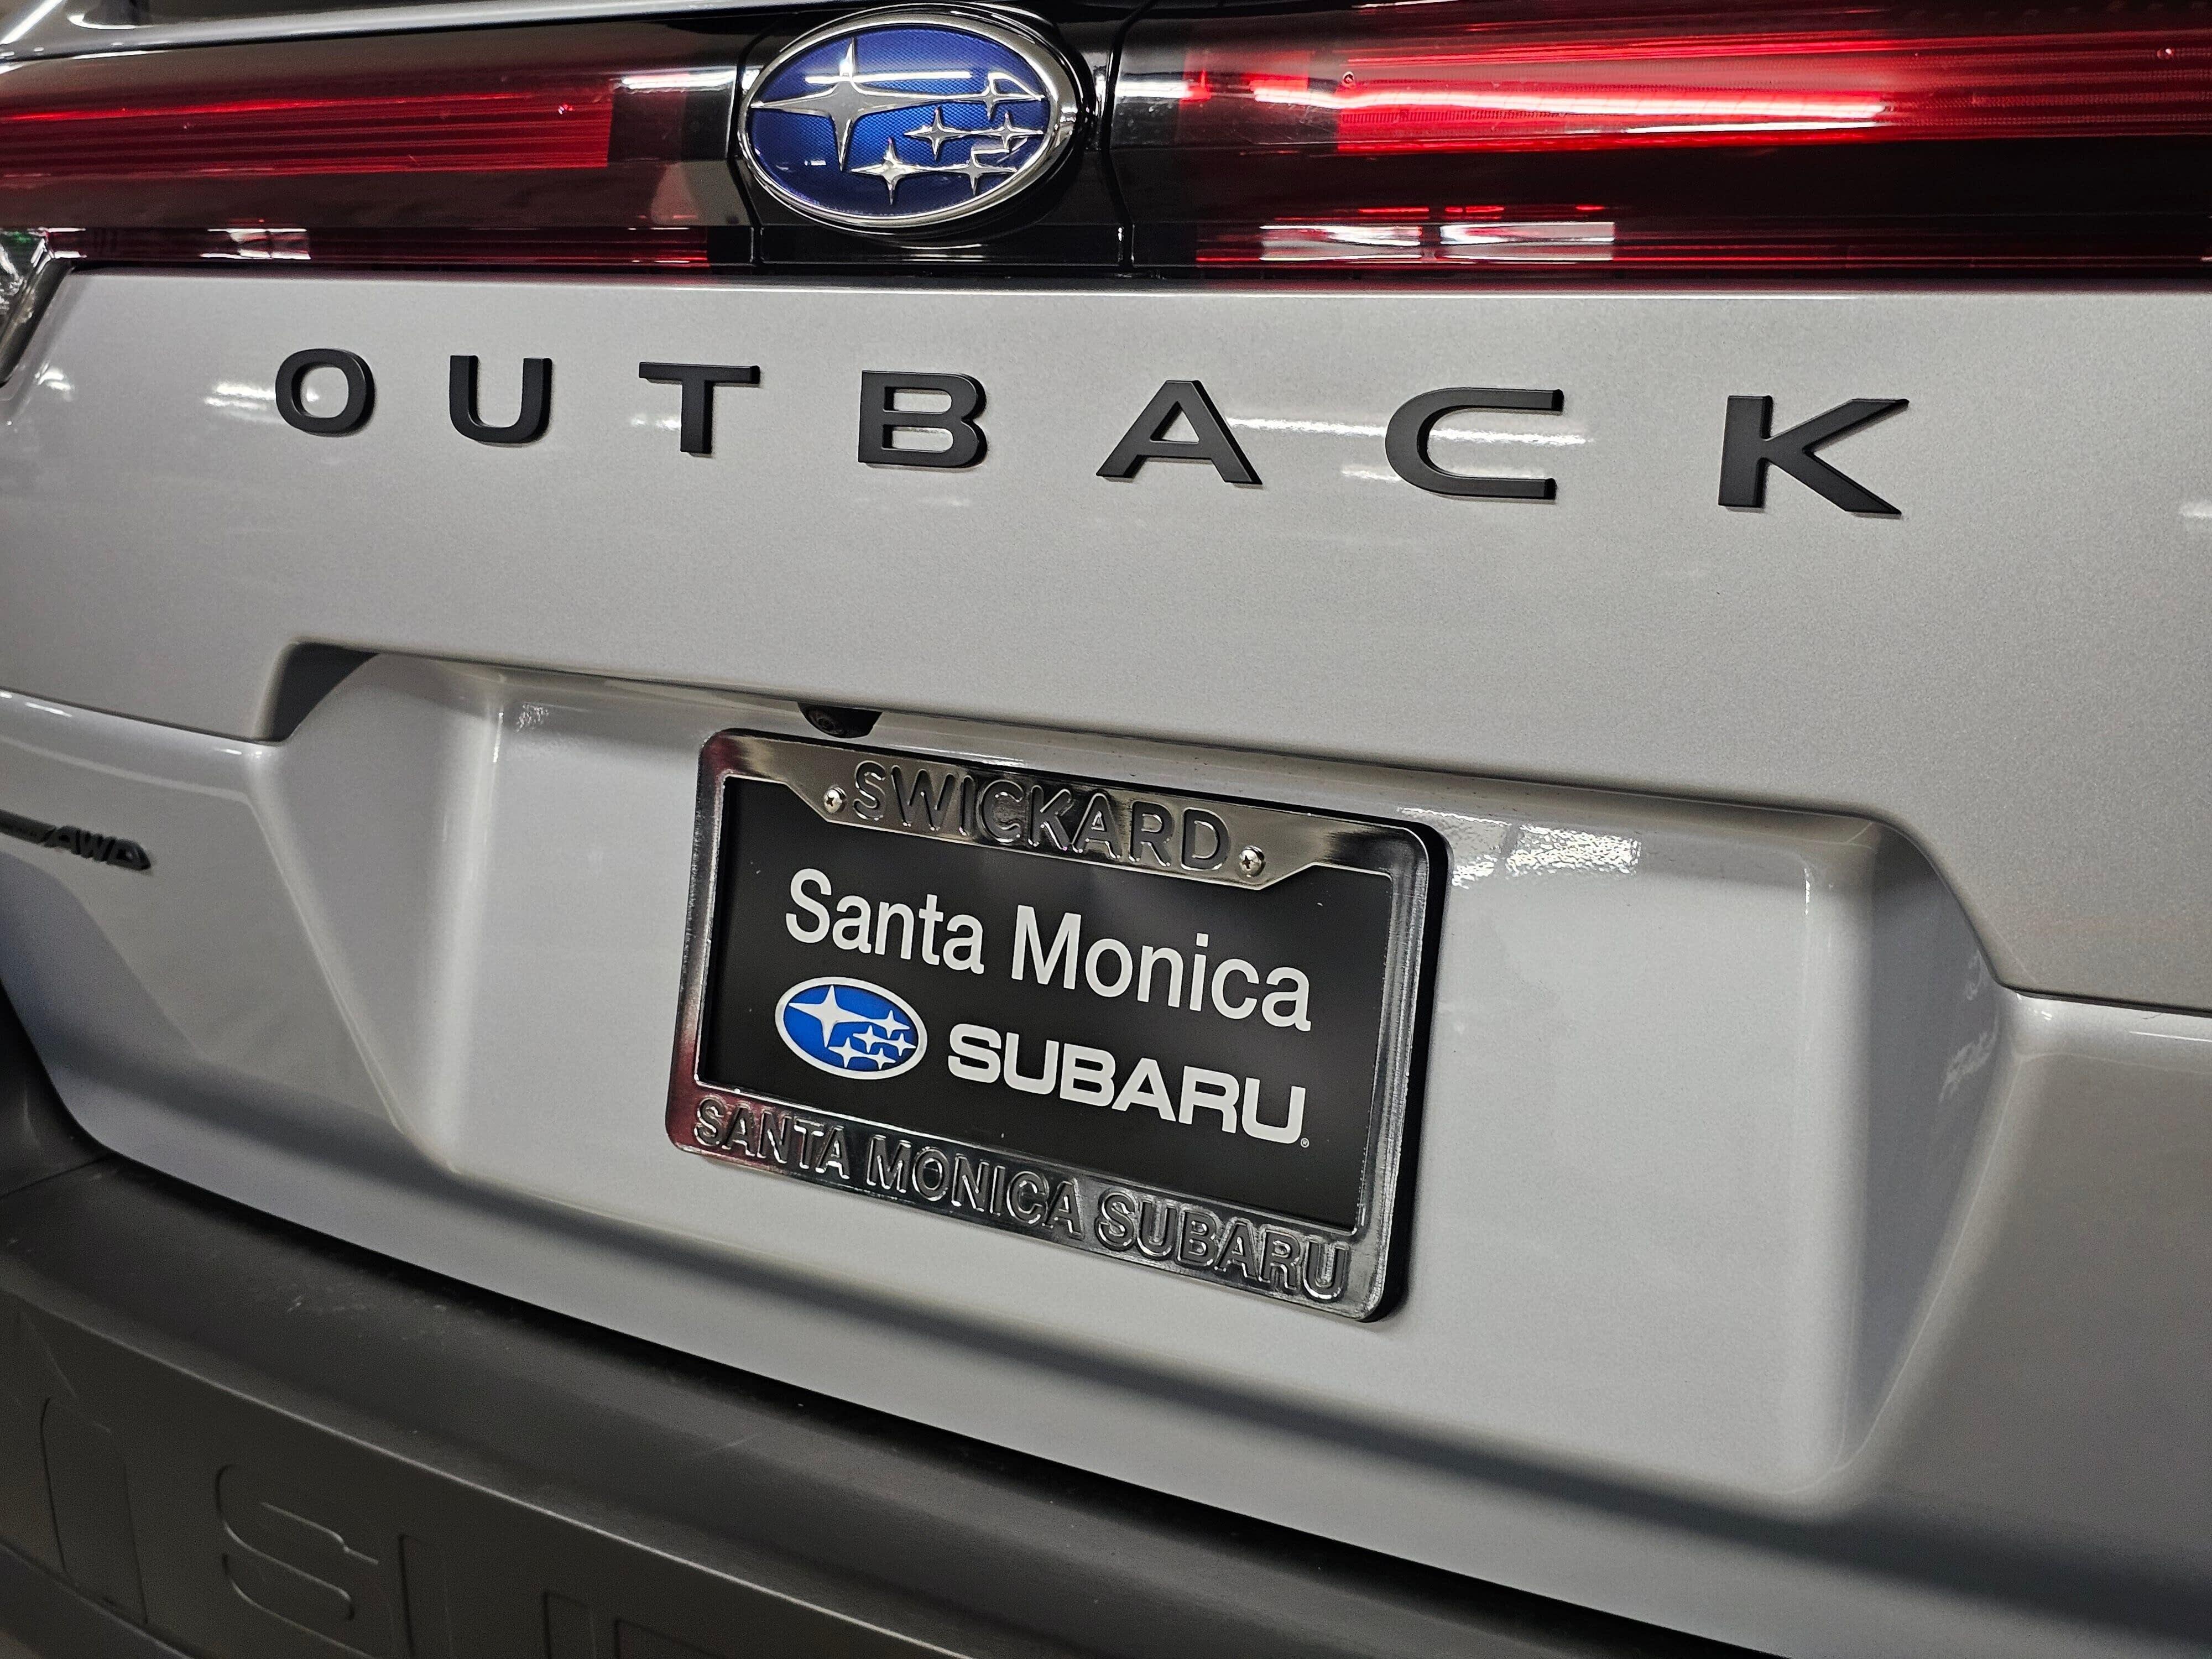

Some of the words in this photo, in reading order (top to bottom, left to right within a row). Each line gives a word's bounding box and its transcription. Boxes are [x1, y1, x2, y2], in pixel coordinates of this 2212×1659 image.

[274, 348, 1910, 519] OUTBACK
[44, 826, 151, 870] AWD
[853, 760, 1232, 872] SWICKARD
[785, 868, 984, 974] Santa
[1011, 905, 1311, 1031] Monica
[694, 1096, 851, 1180] SANTA
[866, 1134, 1086, 1240] MONICA
[1095, 1188, 1351, 1302] SUBARU
